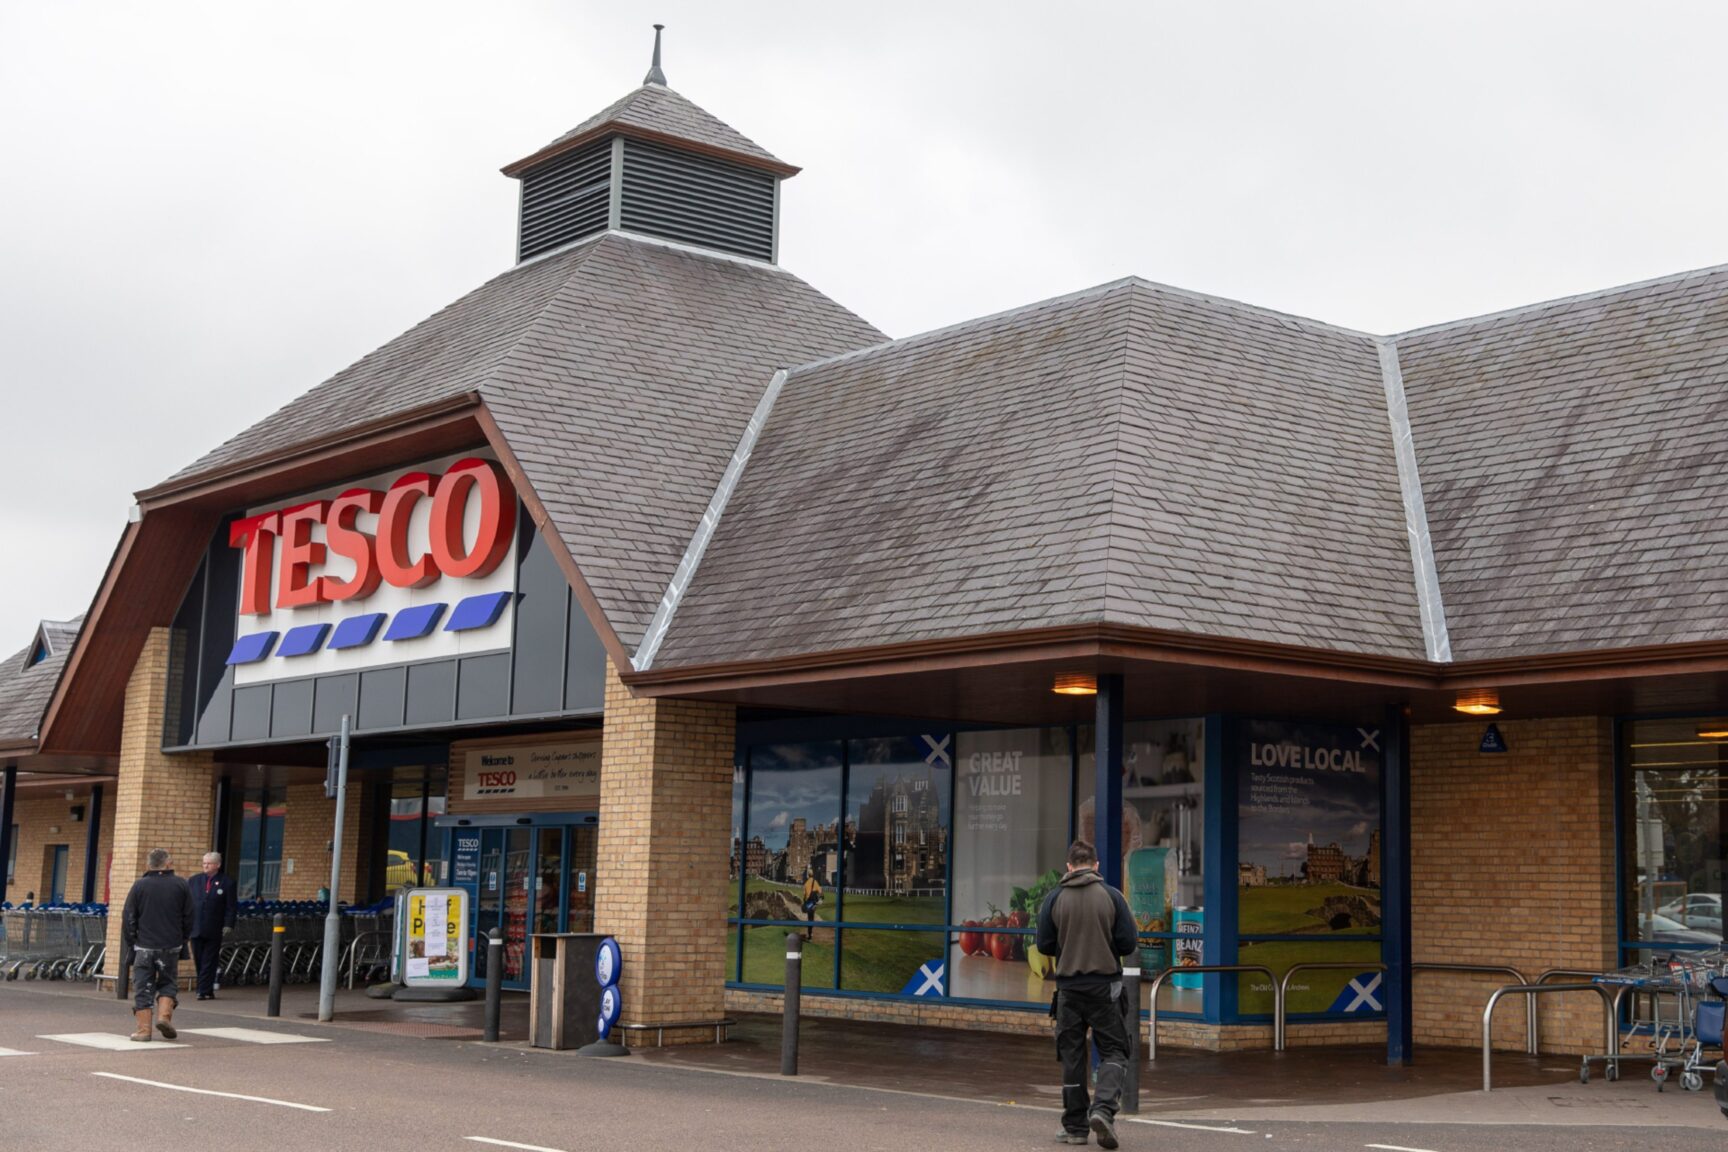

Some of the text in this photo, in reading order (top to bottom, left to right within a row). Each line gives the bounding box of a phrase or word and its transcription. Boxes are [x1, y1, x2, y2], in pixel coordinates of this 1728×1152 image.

[229, 457, 517, 616] TESCO
[481, 755, 514, 766] Welcome to
[969, 751, 1023, 773] GREAT
[1251, 743, 1366, 773] LOVE LOCAL
[478, 770, 516, 787] TESCO
[968, 775, 1022, 796] VALUE
[458, 838, 479, 847] TESCO
[419, 899, 452, 916] Hf
[1175, 938, 1204, 952] BEANZ
